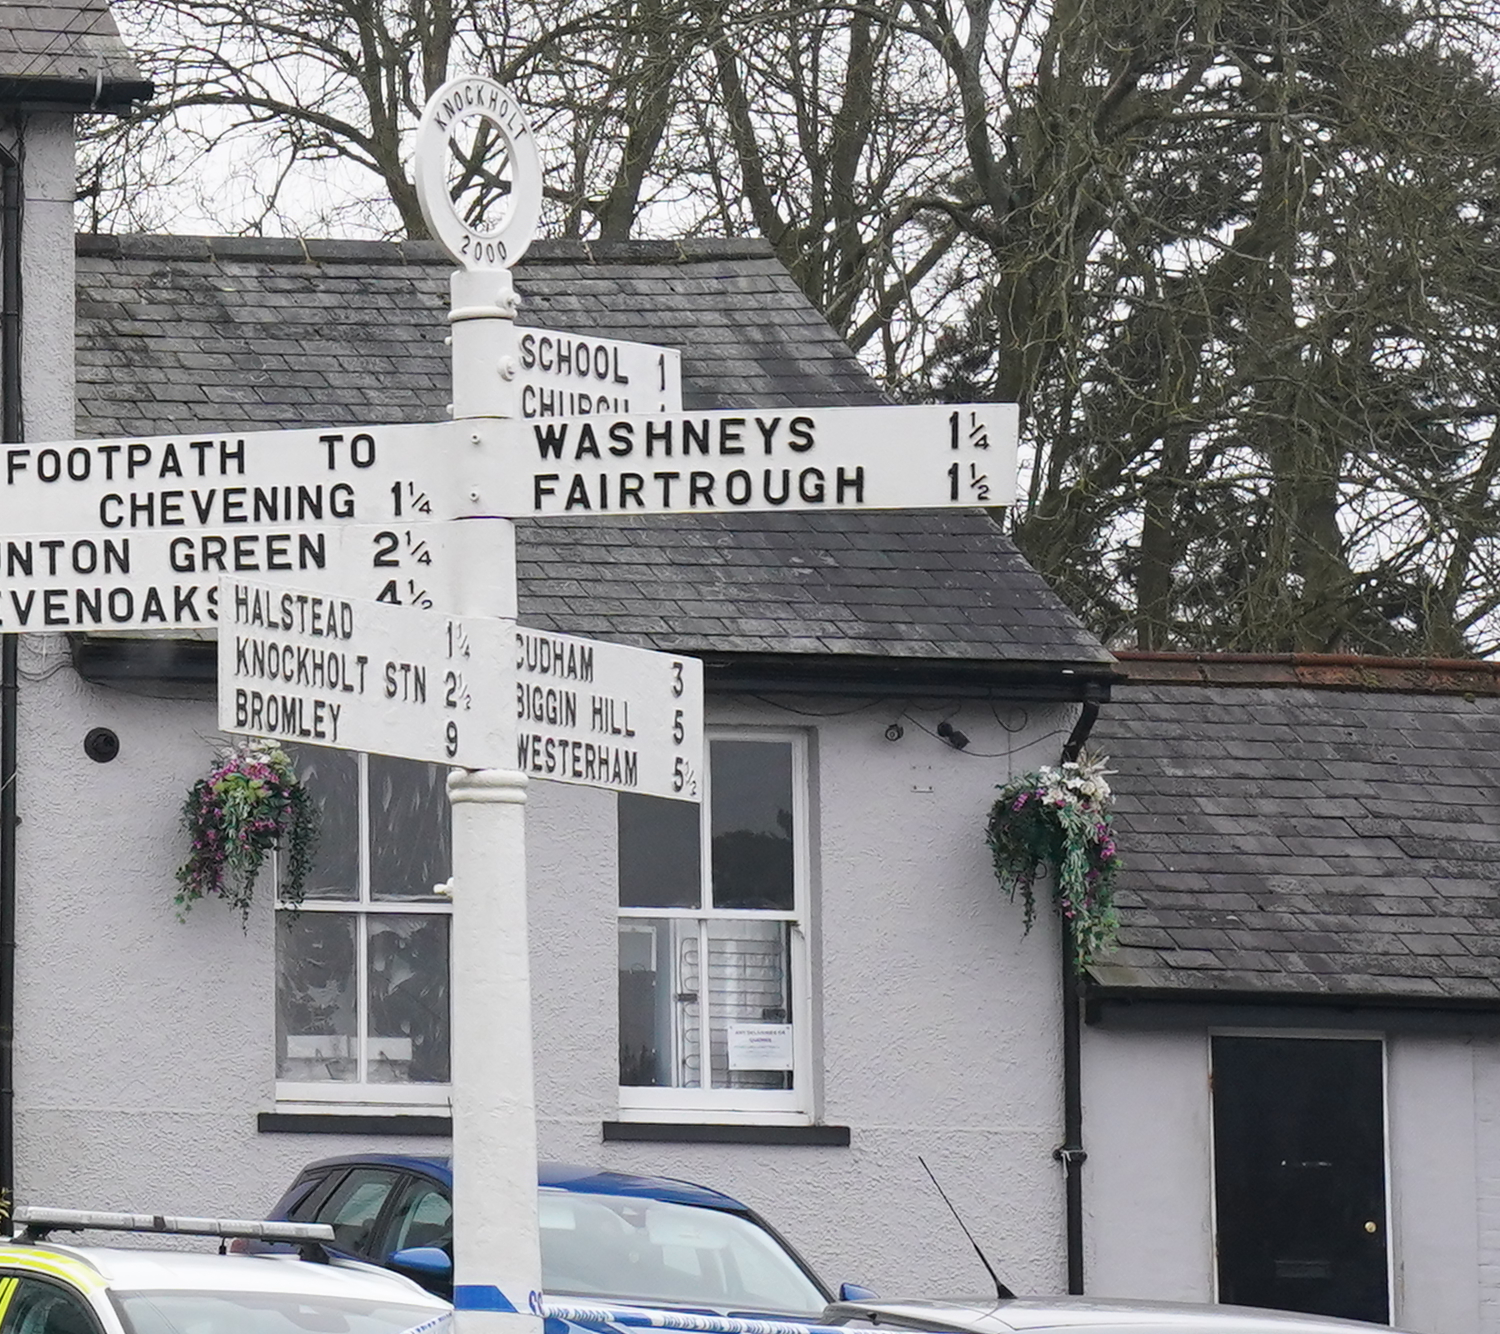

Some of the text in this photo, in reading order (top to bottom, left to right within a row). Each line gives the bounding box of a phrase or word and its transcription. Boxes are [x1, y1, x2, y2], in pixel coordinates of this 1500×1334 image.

[521, 334, 666, 392] SCHOOL 1
[7, 433, 377, 485] FOOTPATH TO
[534, 417, 815, 460] WASHNEYS
[99, 482, 356, 529] CHEVENING
[534, 466, 865, 511] FAIRTROUGH
[169, 532, 327, 572] GREEN
[235, 584, 354, 641] HALSTEAD
[235, 636, 369, 695] KNOCKHOLT
[384, 661, 427, 704] STN
[671, 661, 684, 698] 3
[235, 688, 459, 758] BROMLEY 9
[591, 695, 636, 738] HILL
[672, 709, 684, 745] 5
[517, 732, 638, 787] WESTERHAM
